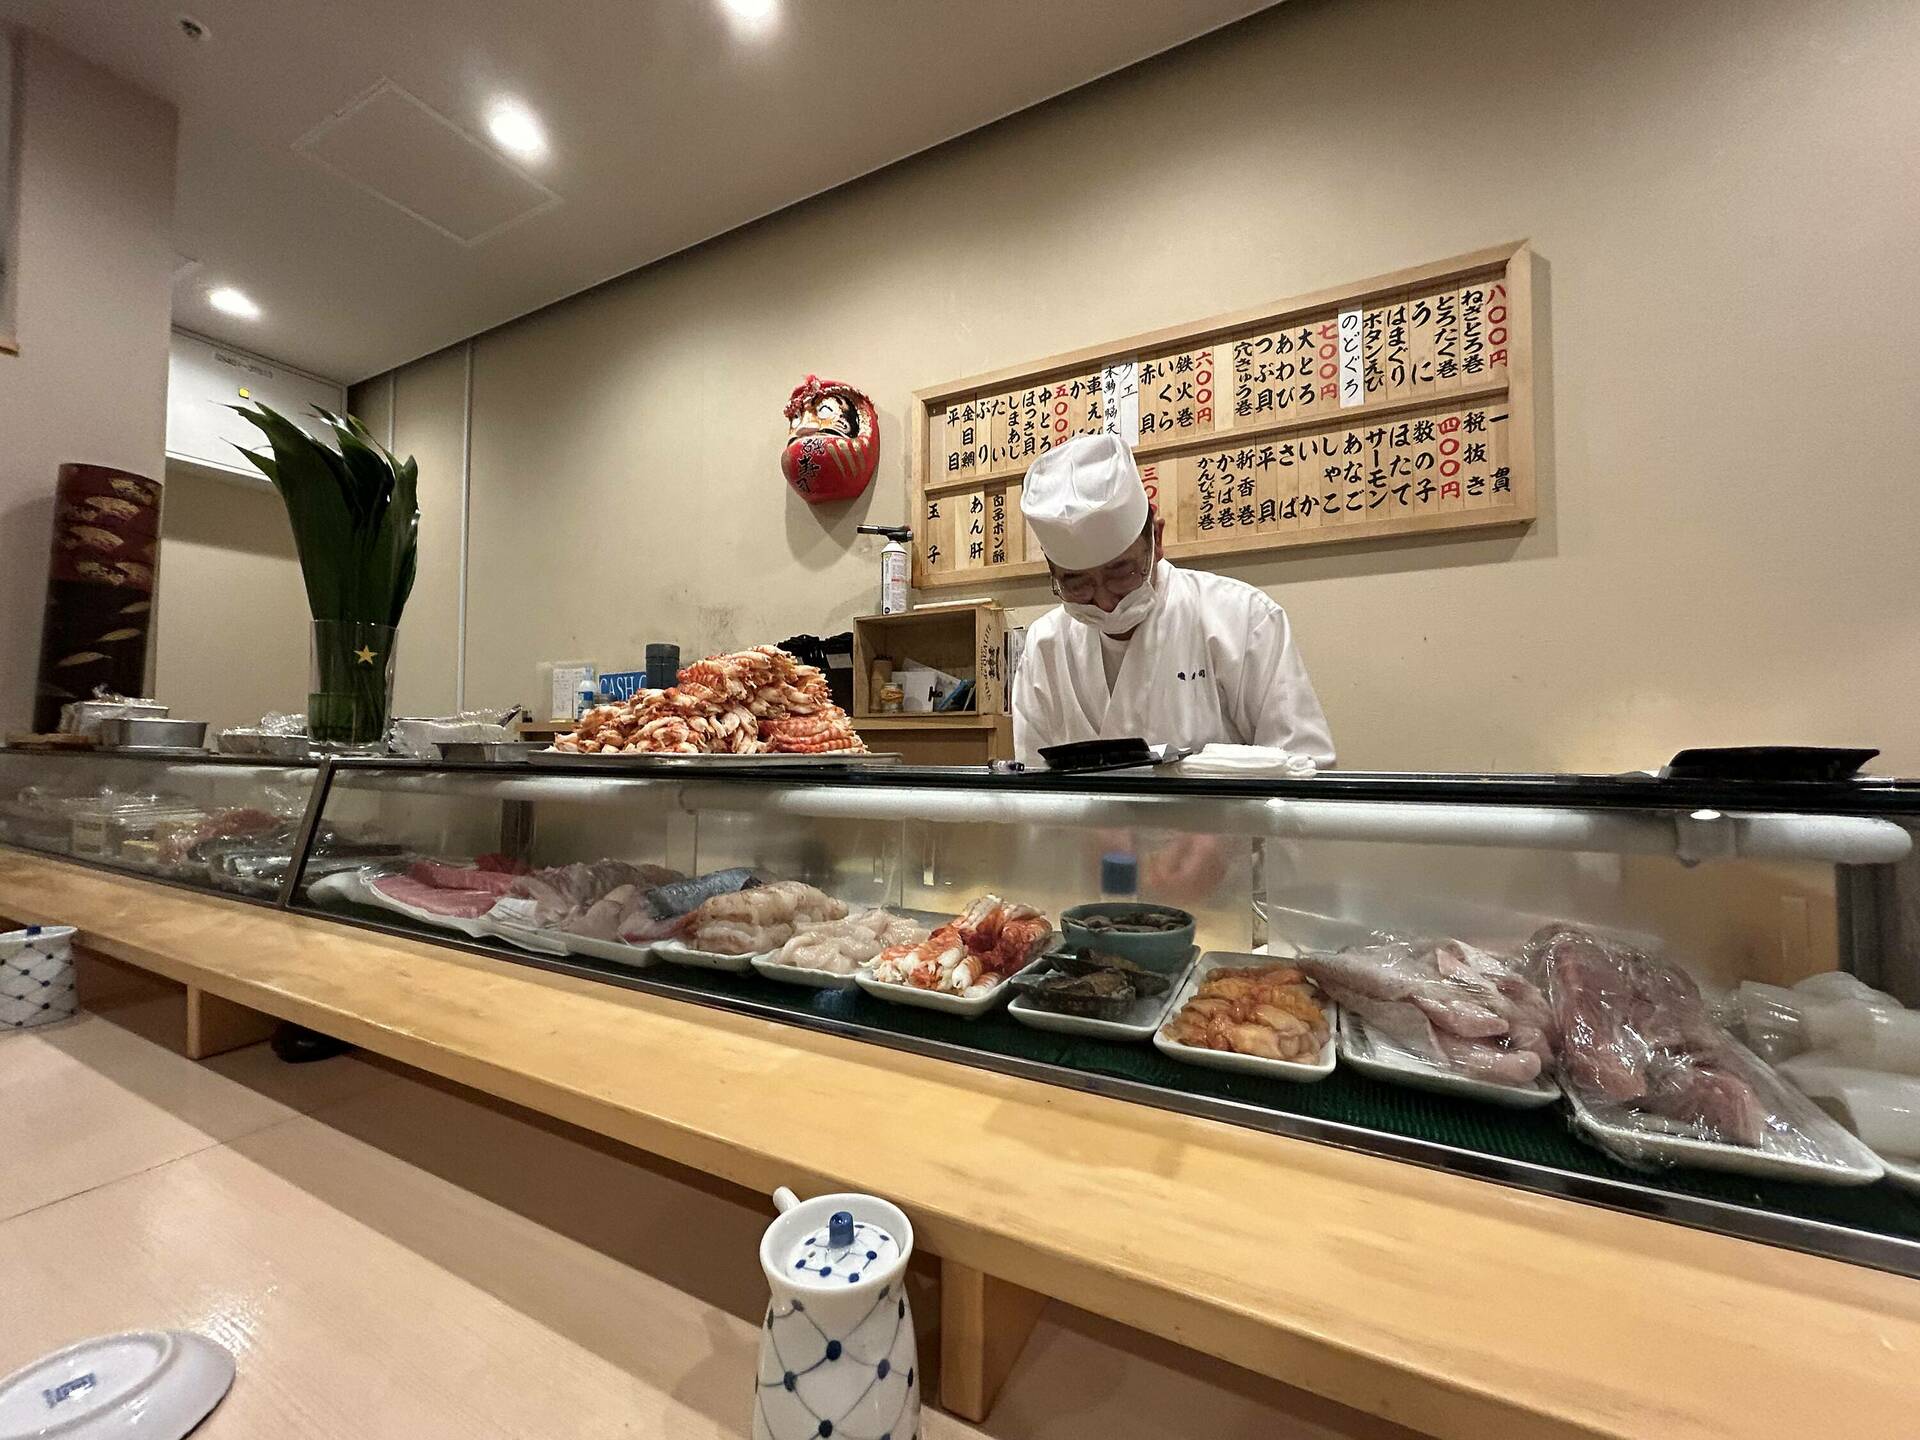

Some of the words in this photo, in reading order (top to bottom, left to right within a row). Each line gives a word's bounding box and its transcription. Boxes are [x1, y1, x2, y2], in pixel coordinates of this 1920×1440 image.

[1297, 328, 1315, 405] 大とろ
[1342, 315, 1360, 398] のどぐろ
[1387, 305, 1408, 387] はまぐり
[1411, 301, 1434, 385] うに
[1435, 296, 1458, 379] とろたく巻
[1461, 290, 1485, 374] ねぎとろ巻
[1070, 381, 1085, 437] か
[1086, 377, 1103, 434] 車え
[1140, 364, 1156, 435] 赤貝
[1158, 360, 1174, 431] いくら
[1176, 355, 1194, 428] 鉄火巻
[1254, 337, 1274, 413] つぶ貝
[1275, 333, 1295, 409] あわび
[947, 407, 961, 471] 平目
[961, 405, 975, 468] 金目鯛
[976, 401, 991, 464] ぶり
[991, 400, 1006, 463] たい
[1008, 395, 1022, 460] しまあじ
[1038, 387, 1052, 454] 中とろ
[1463, 411, 1487, 496] 税抜き
[1489, 413, 1511, 493] 一貫
[1236, 449, 1256, 526] 新香巻
[1256, 446, 1276, 524] 平貝
[1279, 444, 1299, 519] さば
[1299, 440, 1319, 517] いか
[1323, 437, 1341, 514] しゃこ
[1343, 432, 1365, 511] あなご
[1365, 428, 1388, 509] サーモン
[1390, 424, 1411, 506] ほたて
[1413, 420, 1437, 503] 数の子
[928, 503, 940, 564] 玉子
[969, 496, 983, 559] あん肝
[600, 675, 634, 701] CASH
